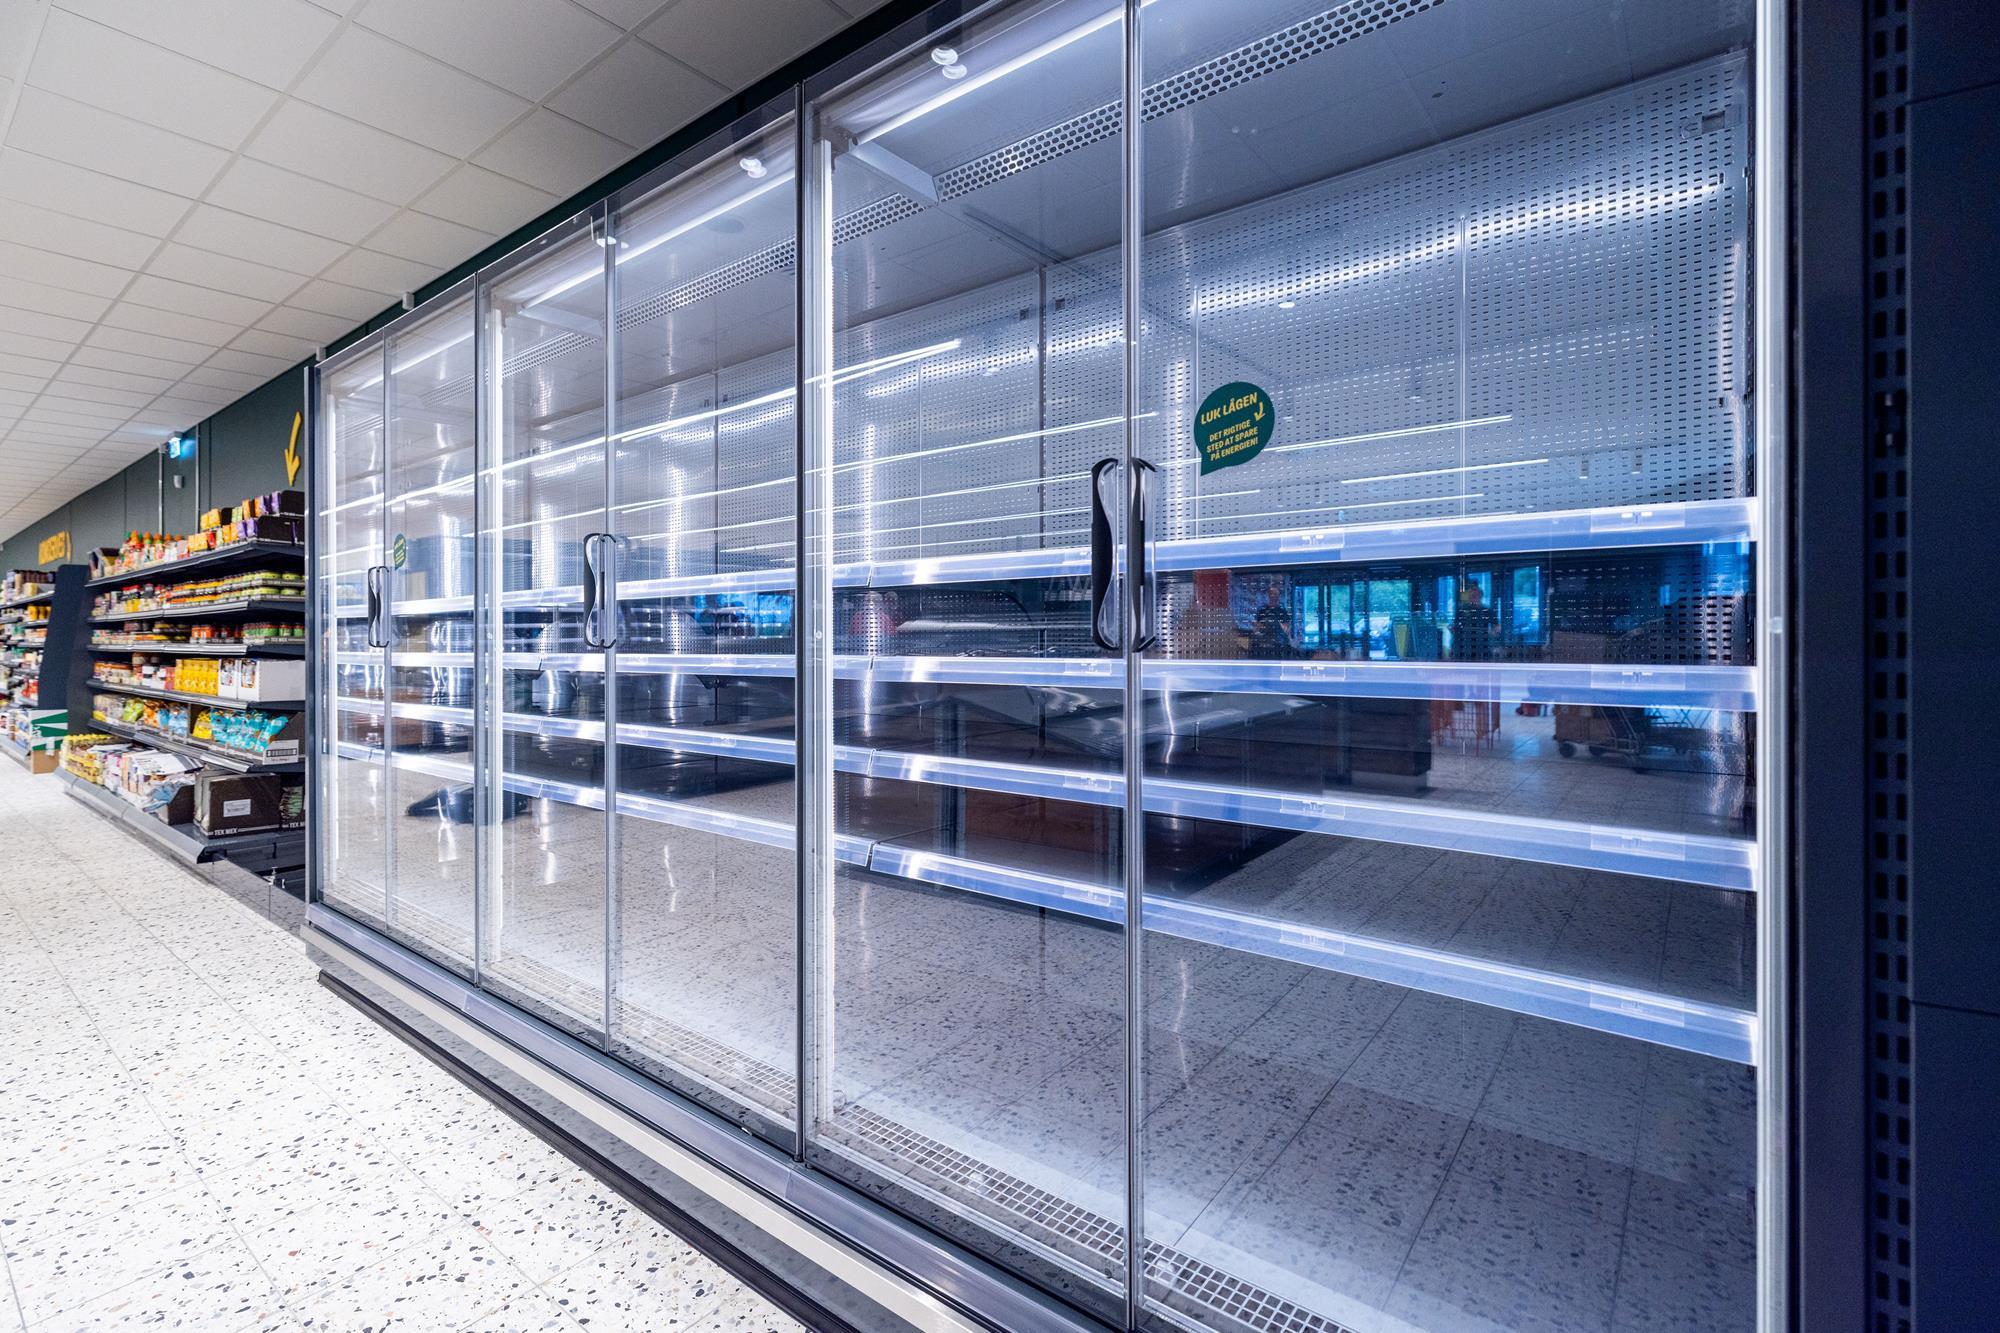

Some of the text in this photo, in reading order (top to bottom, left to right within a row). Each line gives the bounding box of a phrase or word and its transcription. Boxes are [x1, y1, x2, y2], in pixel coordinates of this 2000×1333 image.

[1201, 392, 1257, 424] LUK LÅGEN
[1206, 426, 1258, 453] STED AT SPARE
[1209, 419, 1251, 442] DET RIGTIGE
[1210, 437, 1258, 461] PÅ ENERGIEN!
